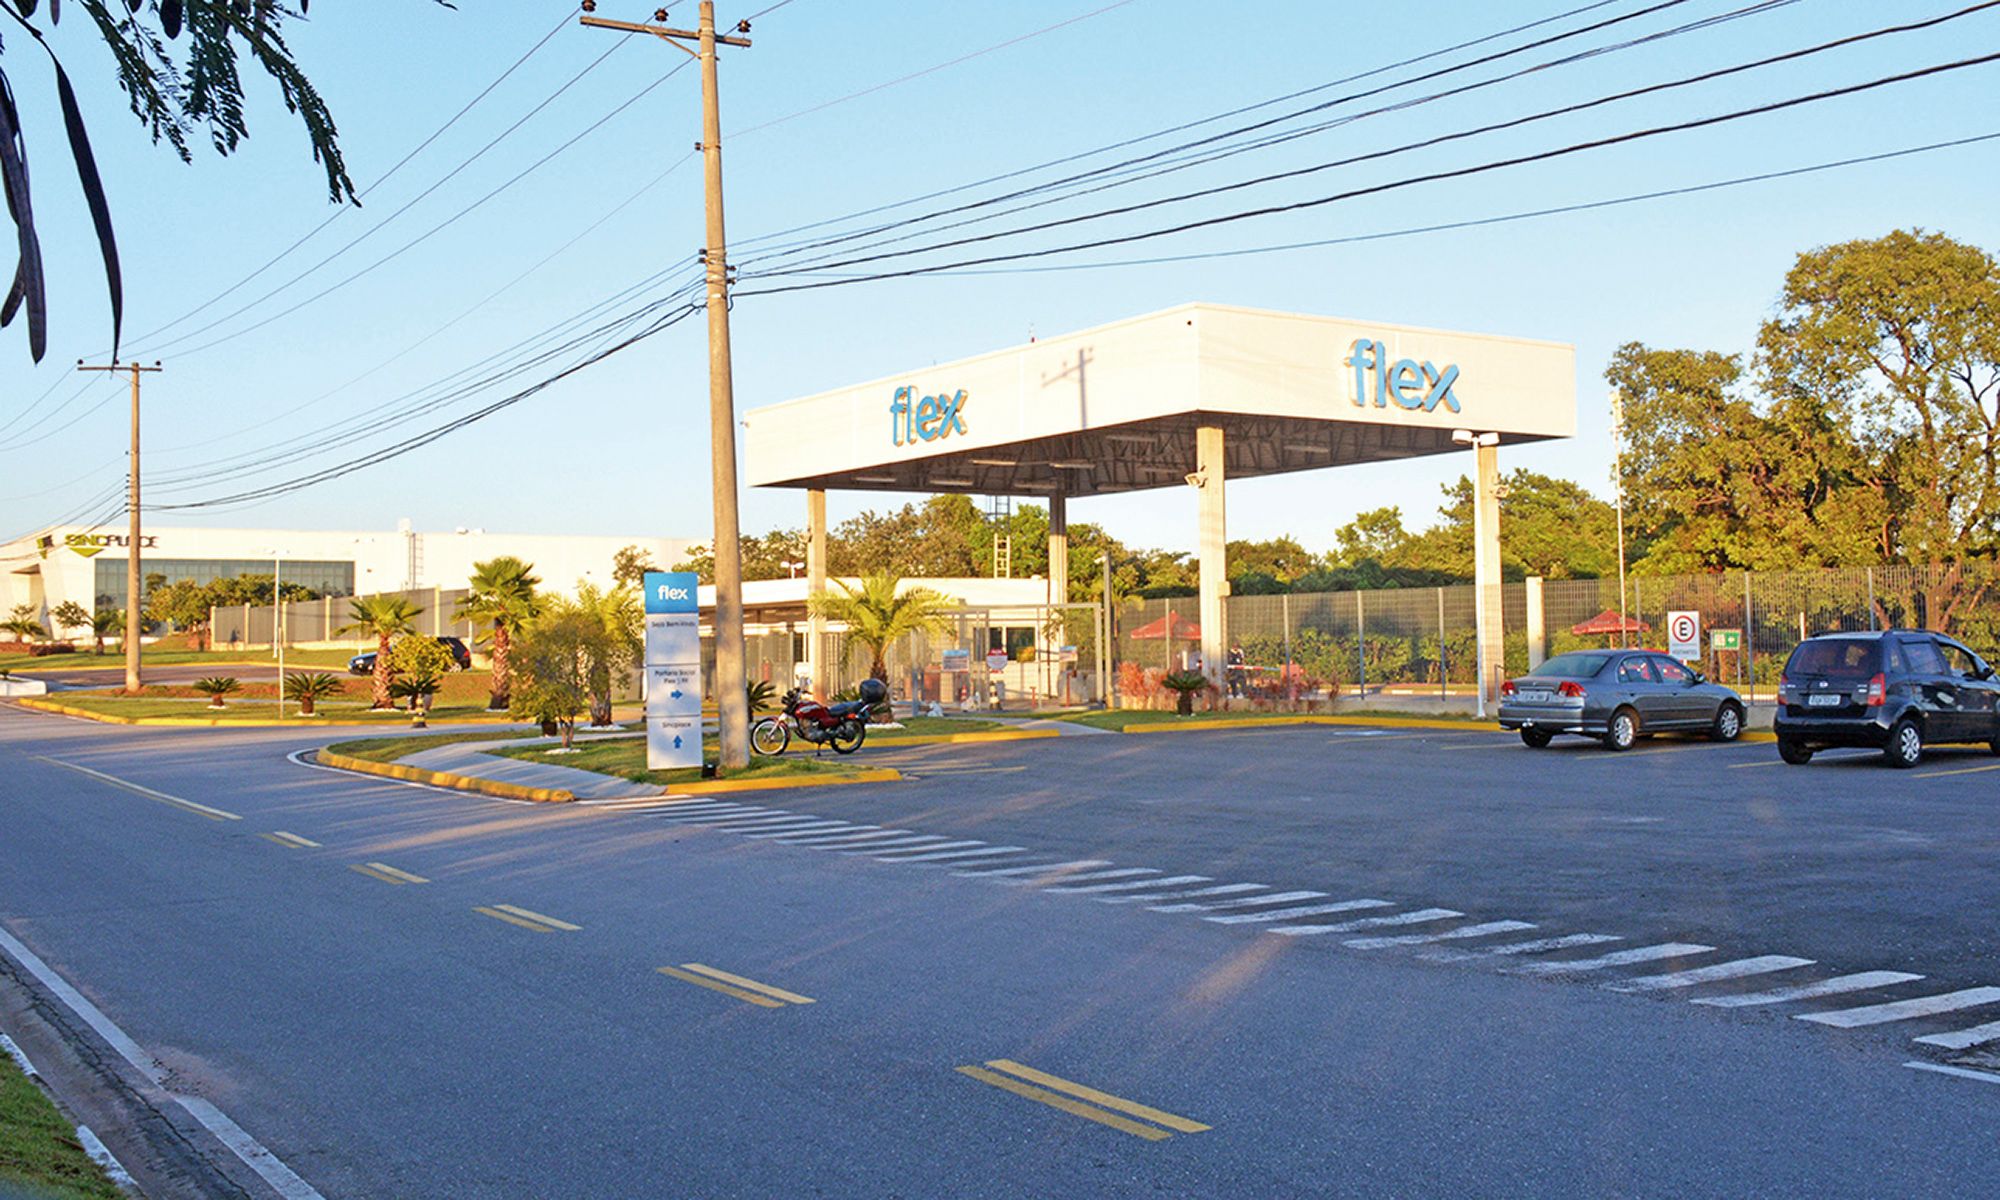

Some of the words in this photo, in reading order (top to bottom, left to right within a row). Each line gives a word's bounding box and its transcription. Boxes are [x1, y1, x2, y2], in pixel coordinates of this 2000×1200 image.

[1345, 338, 1460, 413] flex
[890, 385, 968, 447] flex
[658, 584, 688, 600] flex
[1679, 621, 1688, 636] E
